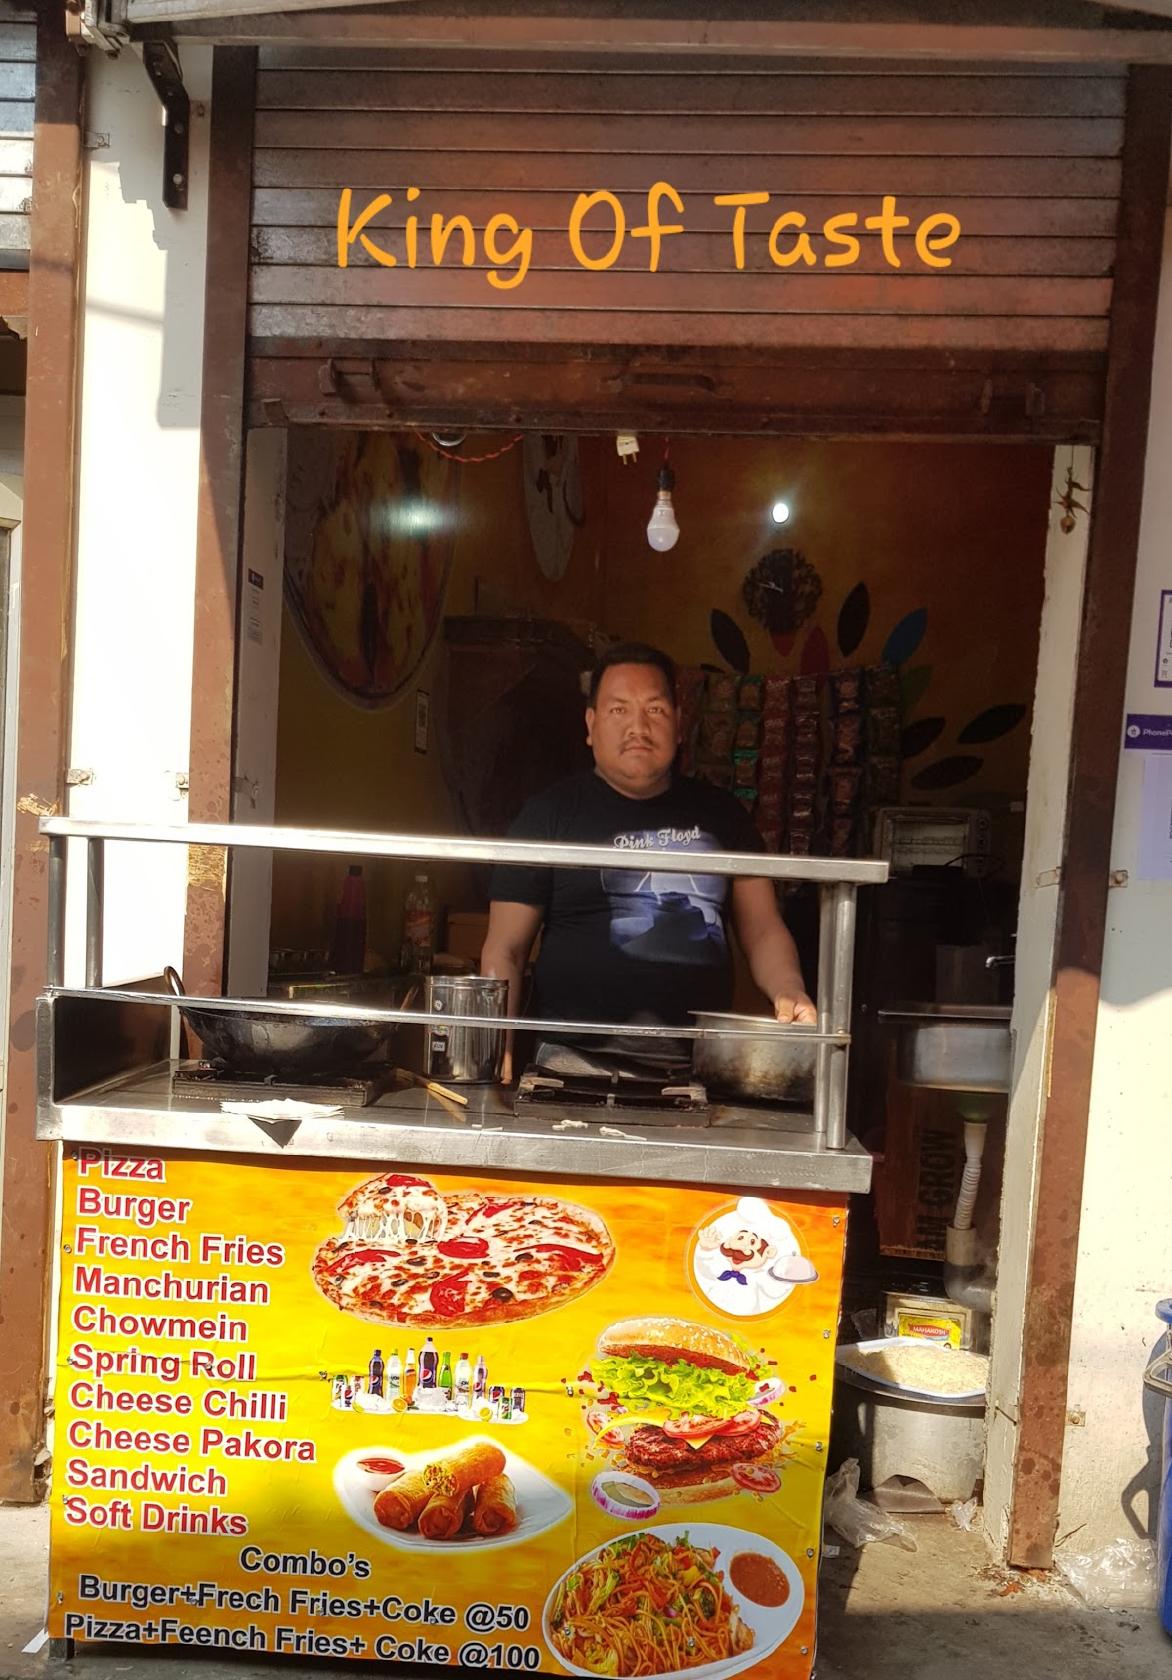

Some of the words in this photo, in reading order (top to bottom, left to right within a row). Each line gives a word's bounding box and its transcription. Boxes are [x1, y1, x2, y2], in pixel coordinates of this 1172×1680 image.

[612, 833, 653, 849] Pink
[657, 825, 700, 846] Floyd
[79, 1148, 165, 1182] Pizza
[78, 1187, 191, 1227] Burger
[76, 1226, 190, 1261] French
[201, 1235, 284, 1266] Fries
[75, 1266, 269, 1303] Manchurian
[73, 1305, 248, 1341] Chowmein
[72, 1343, 180, 1382] Spring
[191, 1351, 256, 1380] Roll
[71, 1382, 192, 1415] Cheese
[204, 1390, 287, 1420] Chilli
[69, 1420, 190, 1453] Cheese
[202, 1428, 316, 1461] Pakora
[67, 1458, 227, 1495] Sandwich
[66, 1497, 132, 1528] Soft
[142, 1503, 248, 1535] Drinks
[239, 1546, 371, 1578] Combo’s
[79, 1574, 280, 1611] Burger+Frech
[290, 1589, 457, 1624] Fries+Coke
[465, 1602, 530, 1633] @50
[66, 1613, 267, 1649] Pizza+Feench
[276, 1627, 366, 1655] Fries+
[375, 1635, 450, 1663] Coke
[459, 1641, 540, 1669] @100
